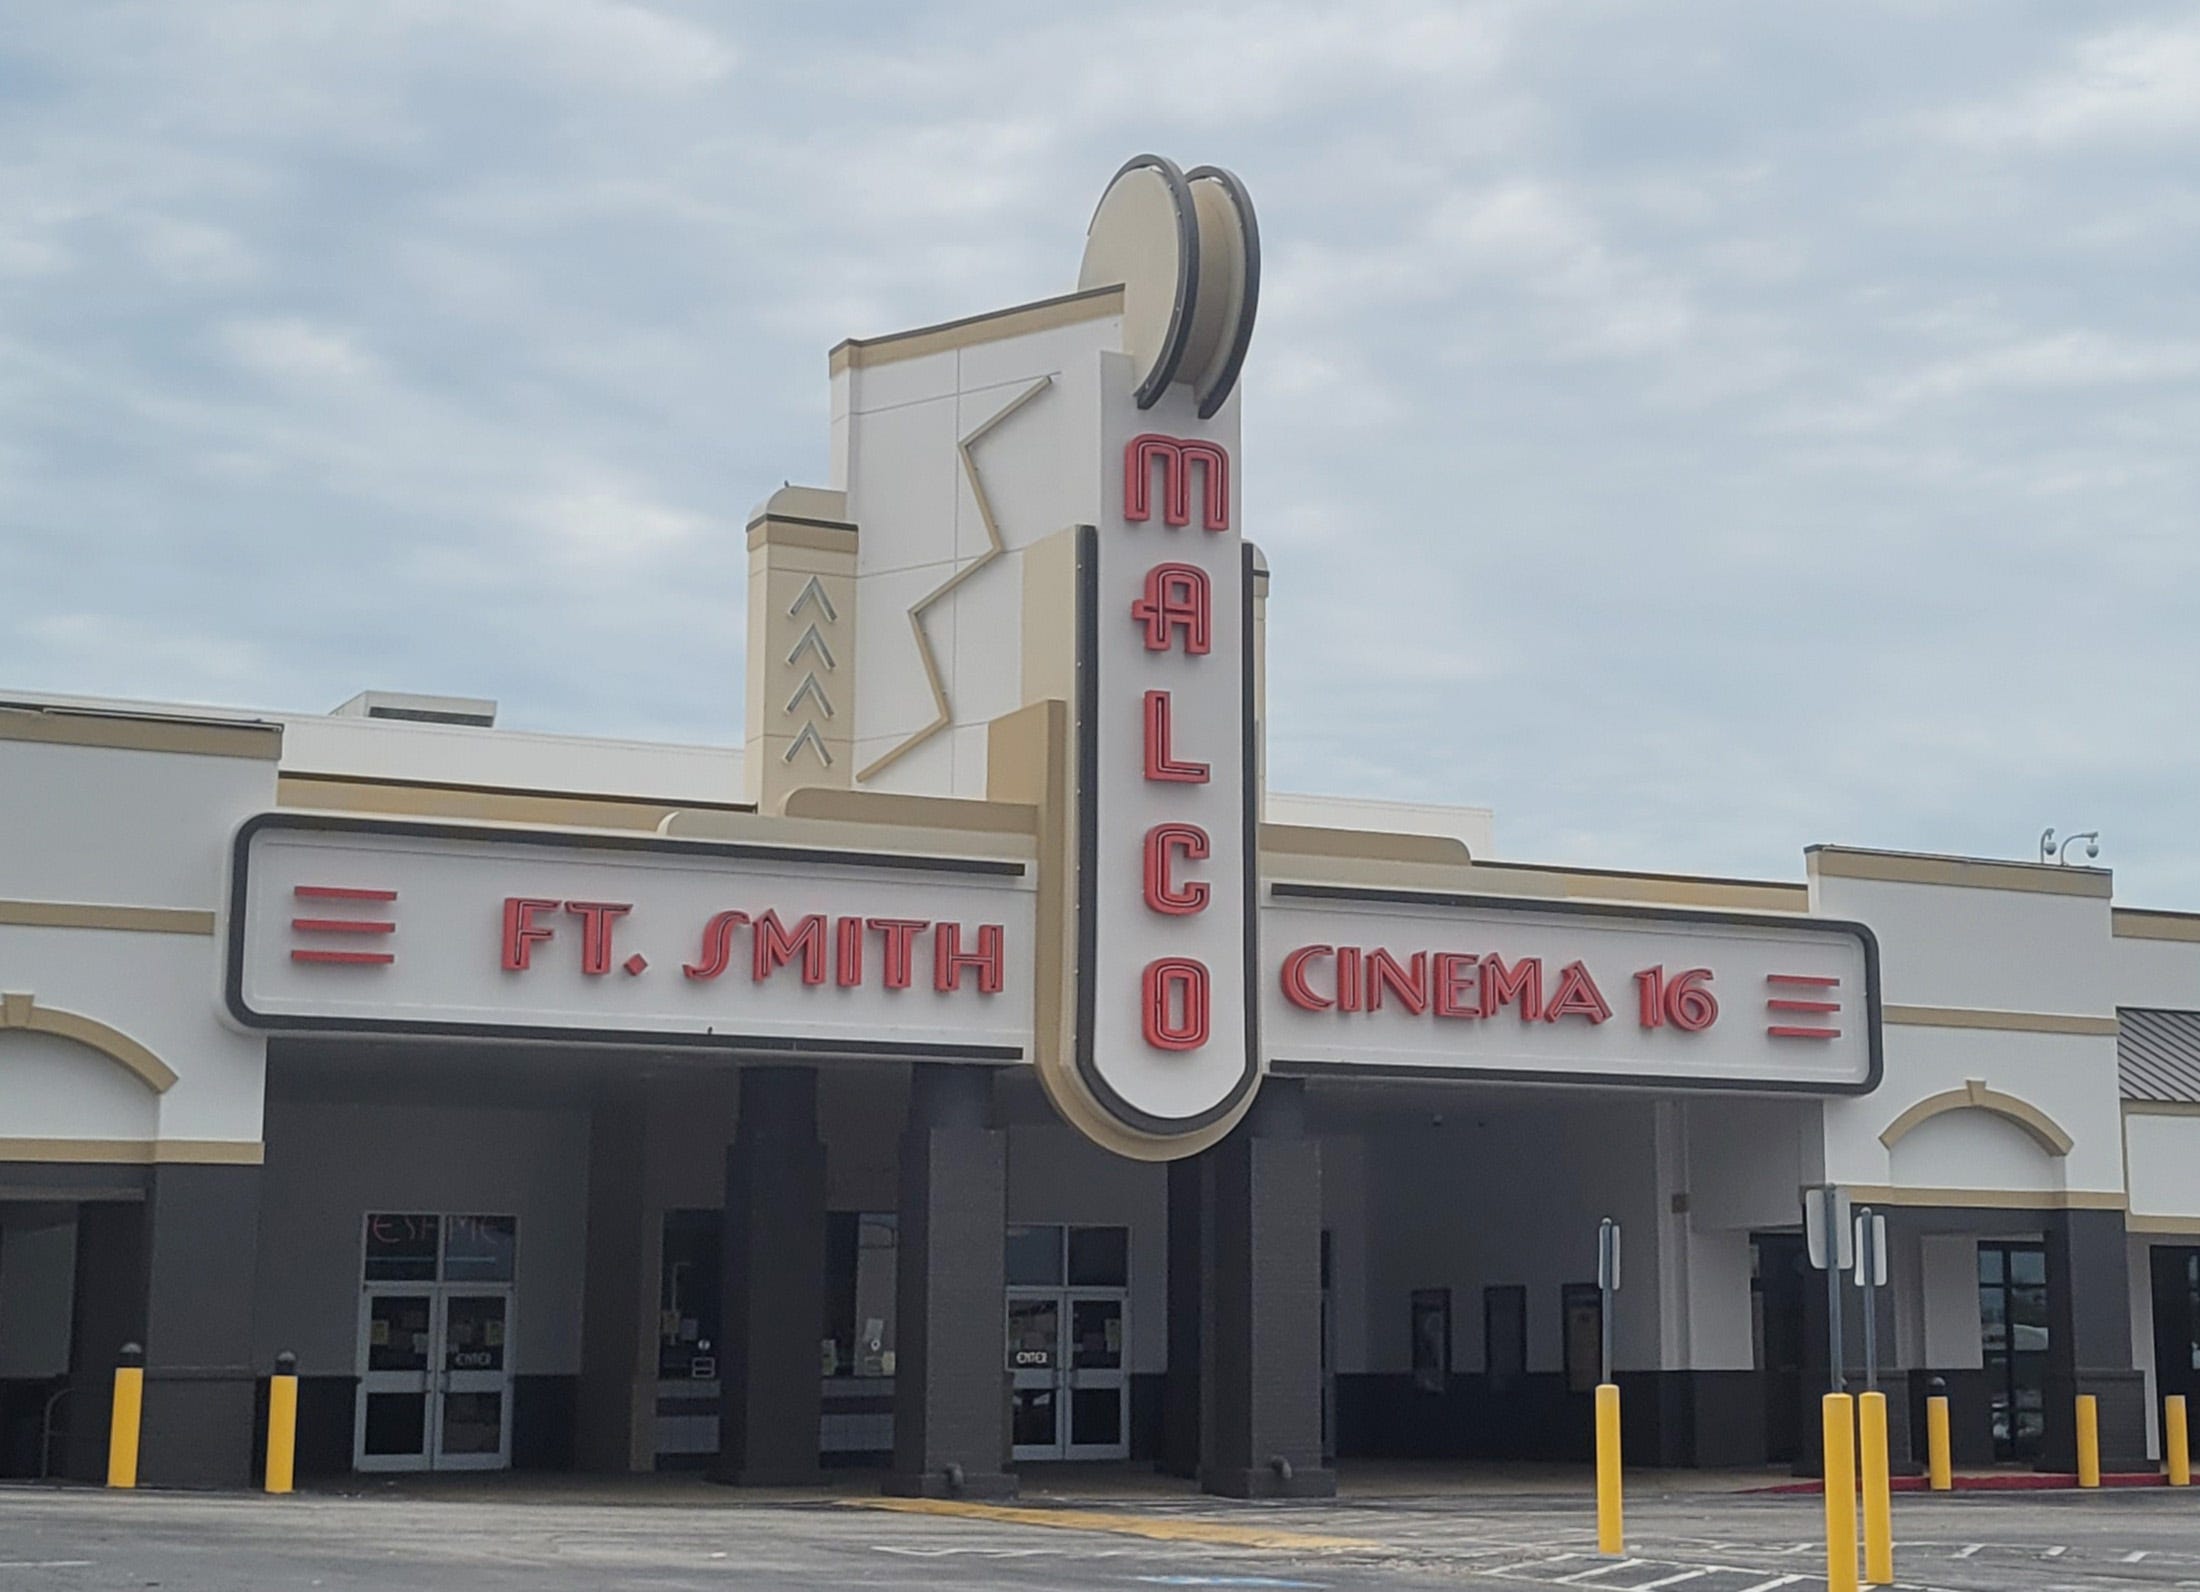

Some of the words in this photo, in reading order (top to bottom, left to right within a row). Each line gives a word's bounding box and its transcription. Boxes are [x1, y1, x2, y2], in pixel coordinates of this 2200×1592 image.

[1124, 434, 1229, 1052] MALCO
[501, 898, 645, 975] FT.
[684, 910, 1005, 994] SMITH
[1280, 946, 1610, 1025] CINEMA
[1637, 967, 1717, 1031] 16
[1015, 1351, 1048, 1364] ENTER
